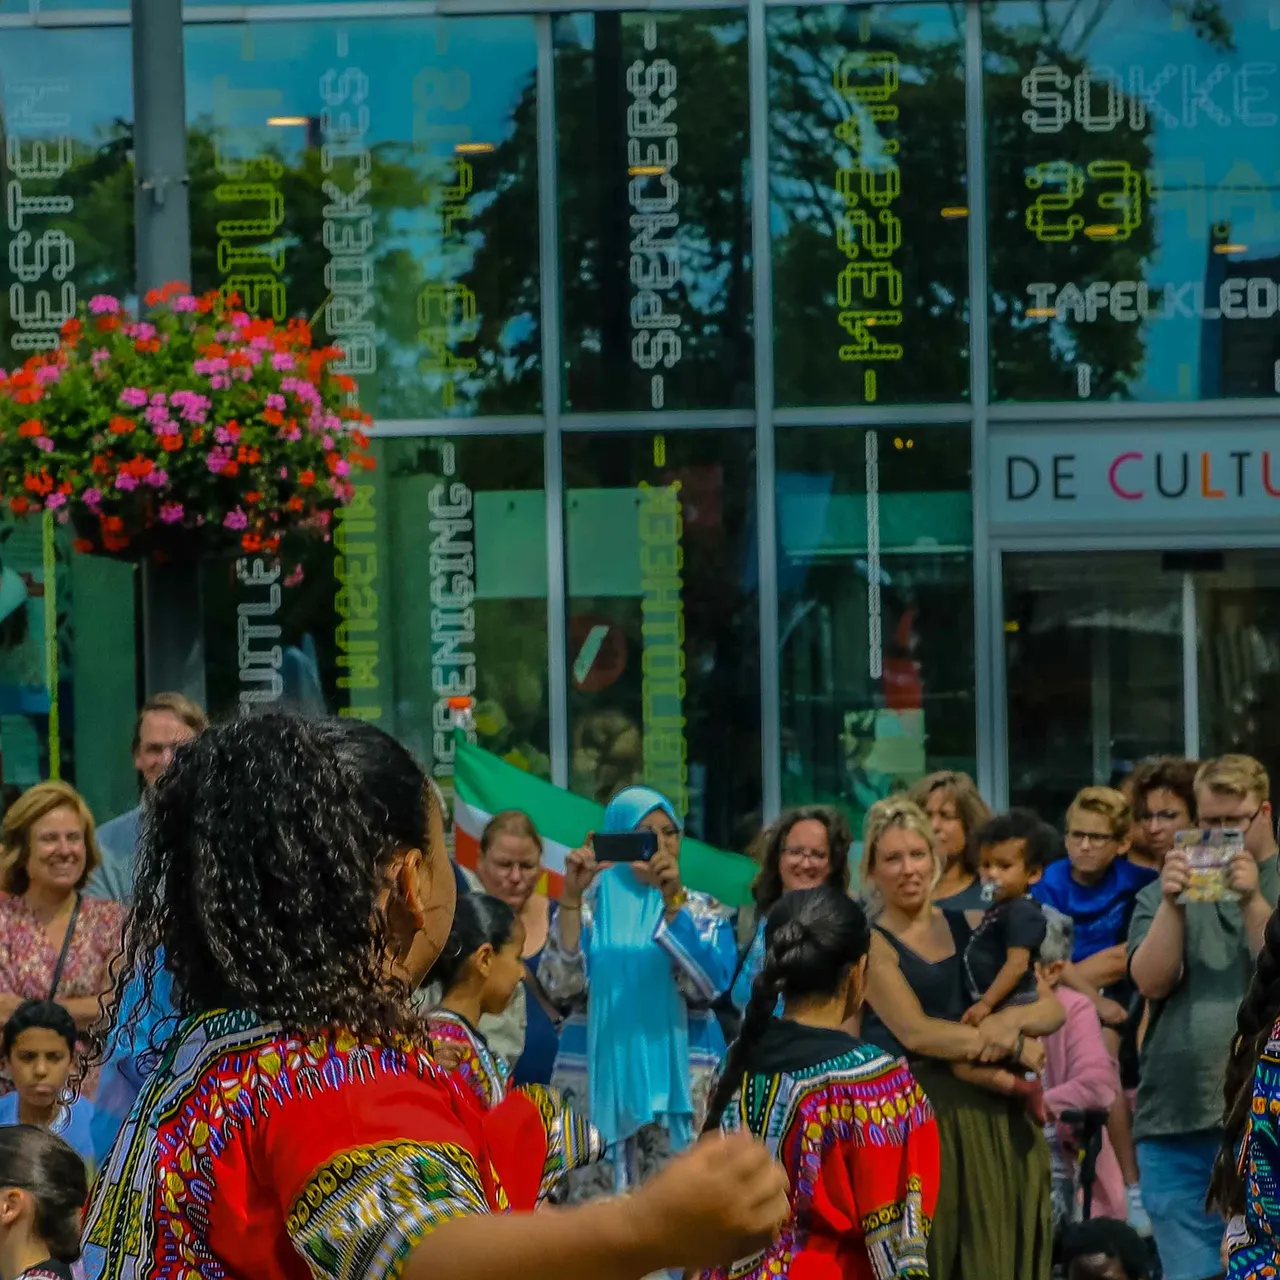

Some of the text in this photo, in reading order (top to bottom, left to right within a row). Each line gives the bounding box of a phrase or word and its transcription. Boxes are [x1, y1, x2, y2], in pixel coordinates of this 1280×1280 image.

[320, 66, 376, 375] BROEKJES
[627, 58, 682, 368] SPENCERS
[1006, 454, 1076, 501] DE
